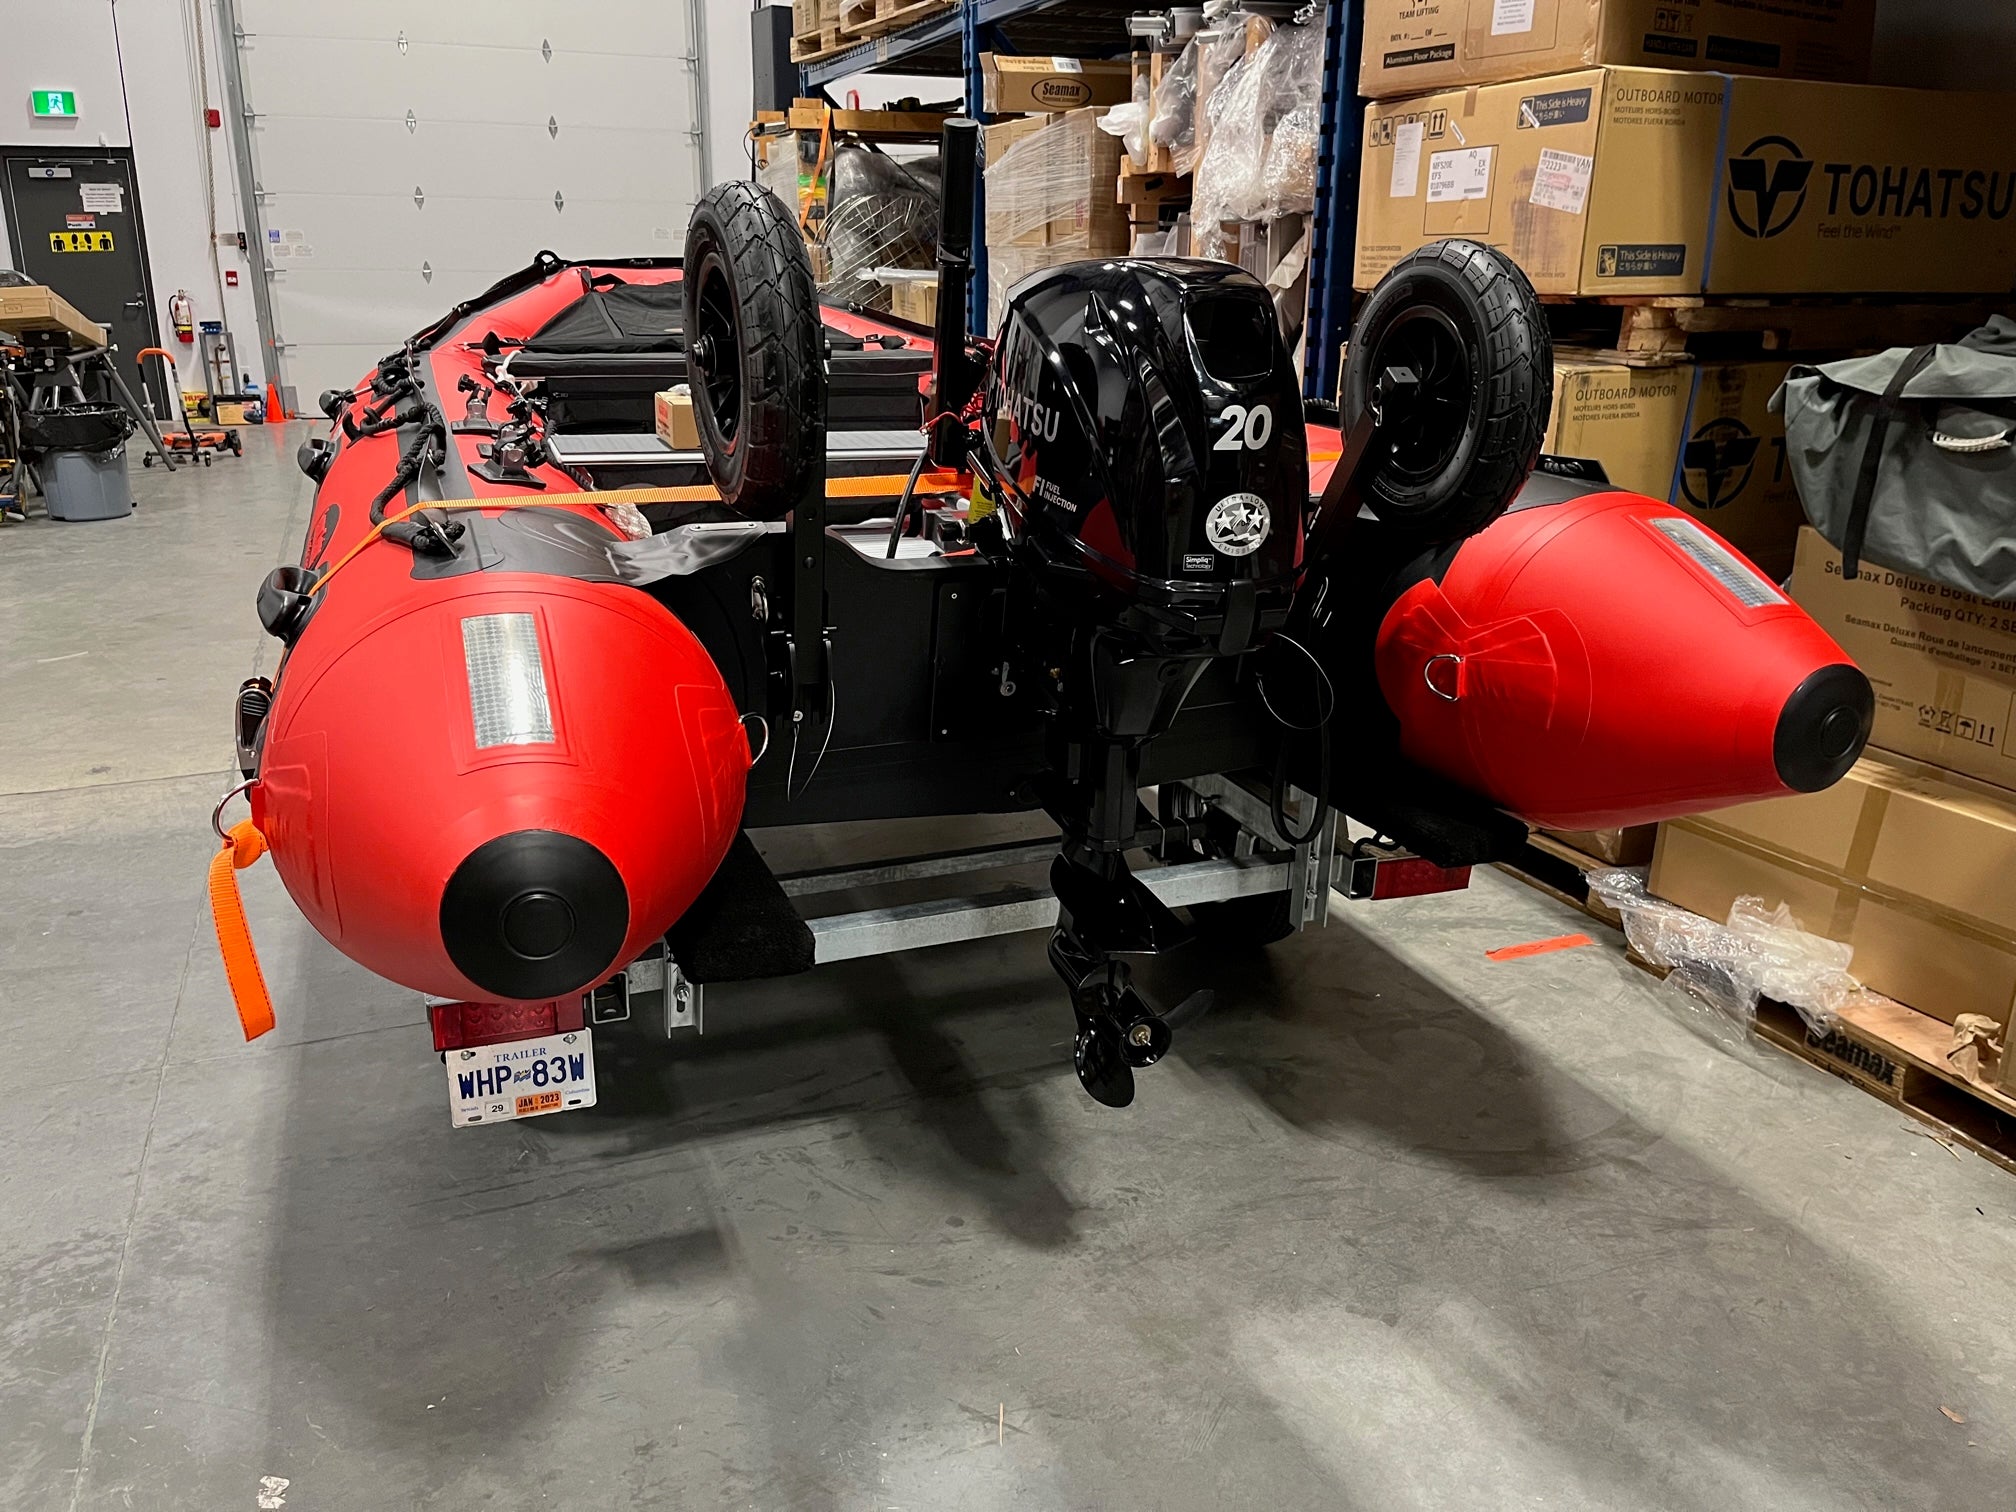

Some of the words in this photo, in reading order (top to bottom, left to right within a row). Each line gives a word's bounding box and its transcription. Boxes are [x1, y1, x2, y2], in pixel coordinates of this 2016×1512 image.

[1399, 9, 1415, 19] TEAM
[1416, 5, 1440, 17] LIFTING
[1385, 55, 1413, 65] Aluminum
[1413, 52, 1430, 61] Floor
[1429, 50, 1453, 59] Package
[1042, 82, 1081, 97] Seamax
[1616, 88, 1680, 103] OUTBOARD
[1683, 91, 1724, 105] MOTOR
[1536, 100, 1548, 110] This
[1548, 99, 1561, 109] Side
[1566, 97, 1588, 107] Heavy
[1613, 117, 1642, 126] MOTORES
[1824, 163, 2016, 220] TOHATSU
[1817, 223, 1841, 238] Feel
[1843, 225, 1863, 238] the
[1620, 250, 1634, 260] This
[1635, 250, 1652, 261] Side
[1658, 251, 1681, 263] Heavy
[1575, 387, 1636, 401] OUTBOARD
[1638, 384, 1678, 398] MOTOR
[1574, 404, 1601, 412] MOTEURS
[1213, 404, 1273, 451] 20
[1045, 480, 1061, 496] FUEL
[1043, 490, 1078, 513] INJECTION
[1884, 572, 1937, 595] Deluxe
[1900, 597, 1952, 620] Packing
[1955, 608, 1987, 627] QTY:
[1990, 616, 1998, 629] 2
[1845, 614, 1882, 630] Seamax
[1883, 623, 1916, 638] Deluxe
[1919, 631, 1945, 645] Roue
[1946, 639, 1959, 649] de
[494, 1048, 547, 1063] TRAILER
[457, 1066, 512, 1100] WHP
[532, 1053, 585, 1087] 83W
[518, 1099, 533, 1108] JAN
[540, 1093, 560, 1104] 2023
[491, 1105, 504, 1113] 29
